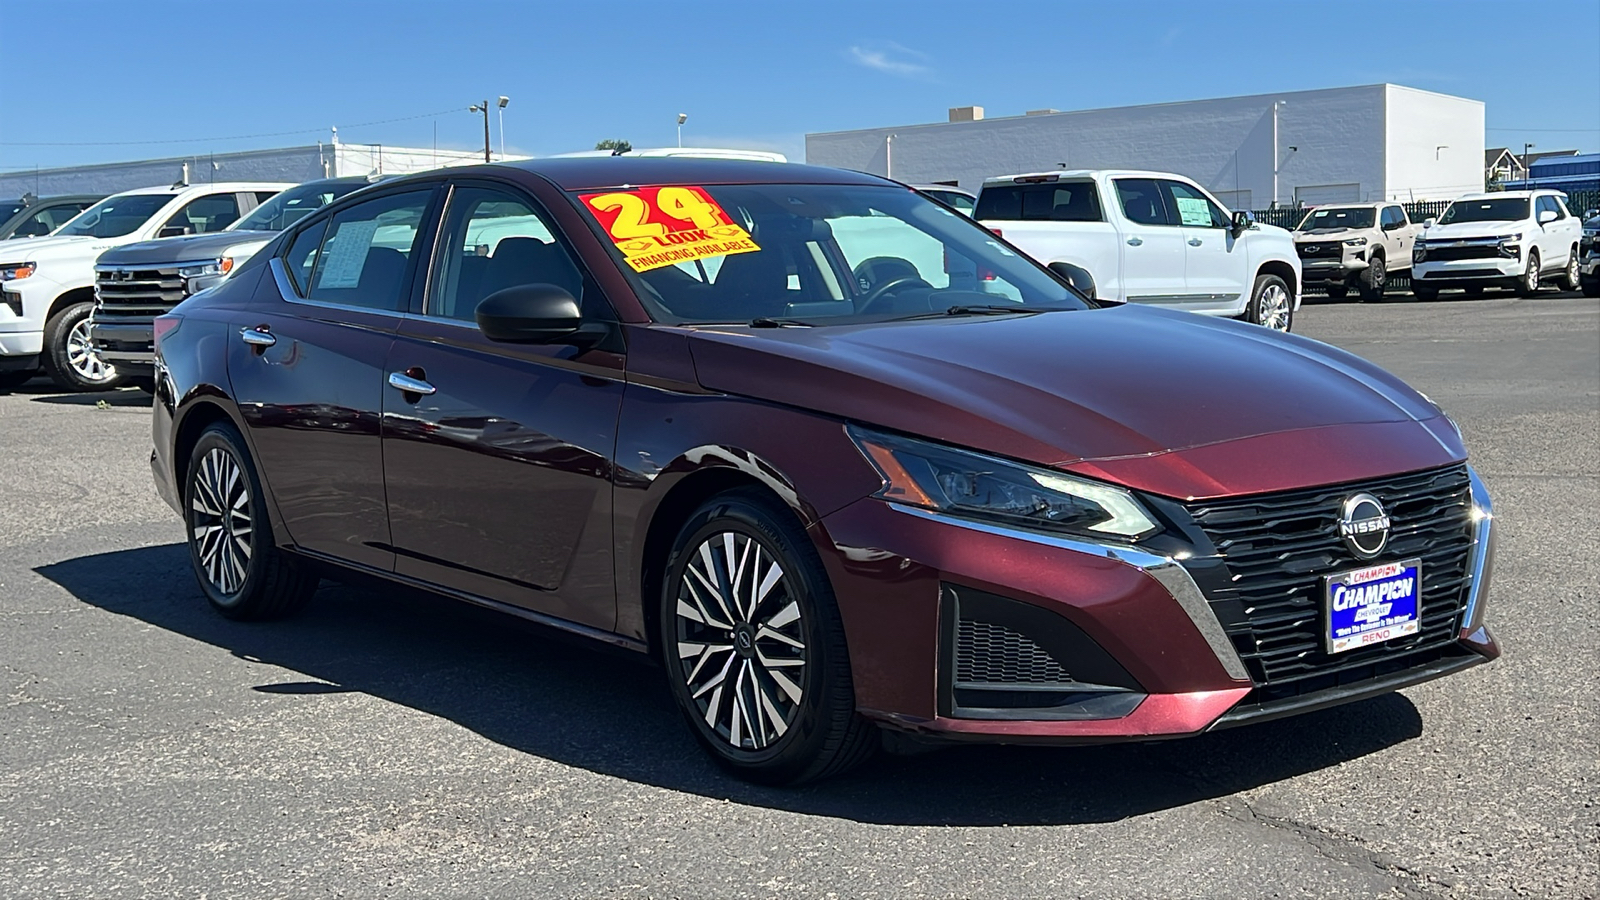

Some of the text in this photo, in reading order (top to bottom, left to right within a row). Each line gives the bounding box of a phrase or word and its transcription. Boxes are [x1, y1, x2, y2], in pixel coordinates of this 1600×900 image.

[589, 187, 720, 239] 24
[652, 229, 713, 247] LOOK
[631, 240, 754, 268] FINANCING AVAILABLE
[1341, 517, 1390, 535] NISSAN
[1354, 565, 1397, 582] CHAMPION
[1333, 577, 1414, 612] CHAMPION
[1357, 606, 1389, 618] CHEVROLET
[1362, 629, 1391, 643] RENO
